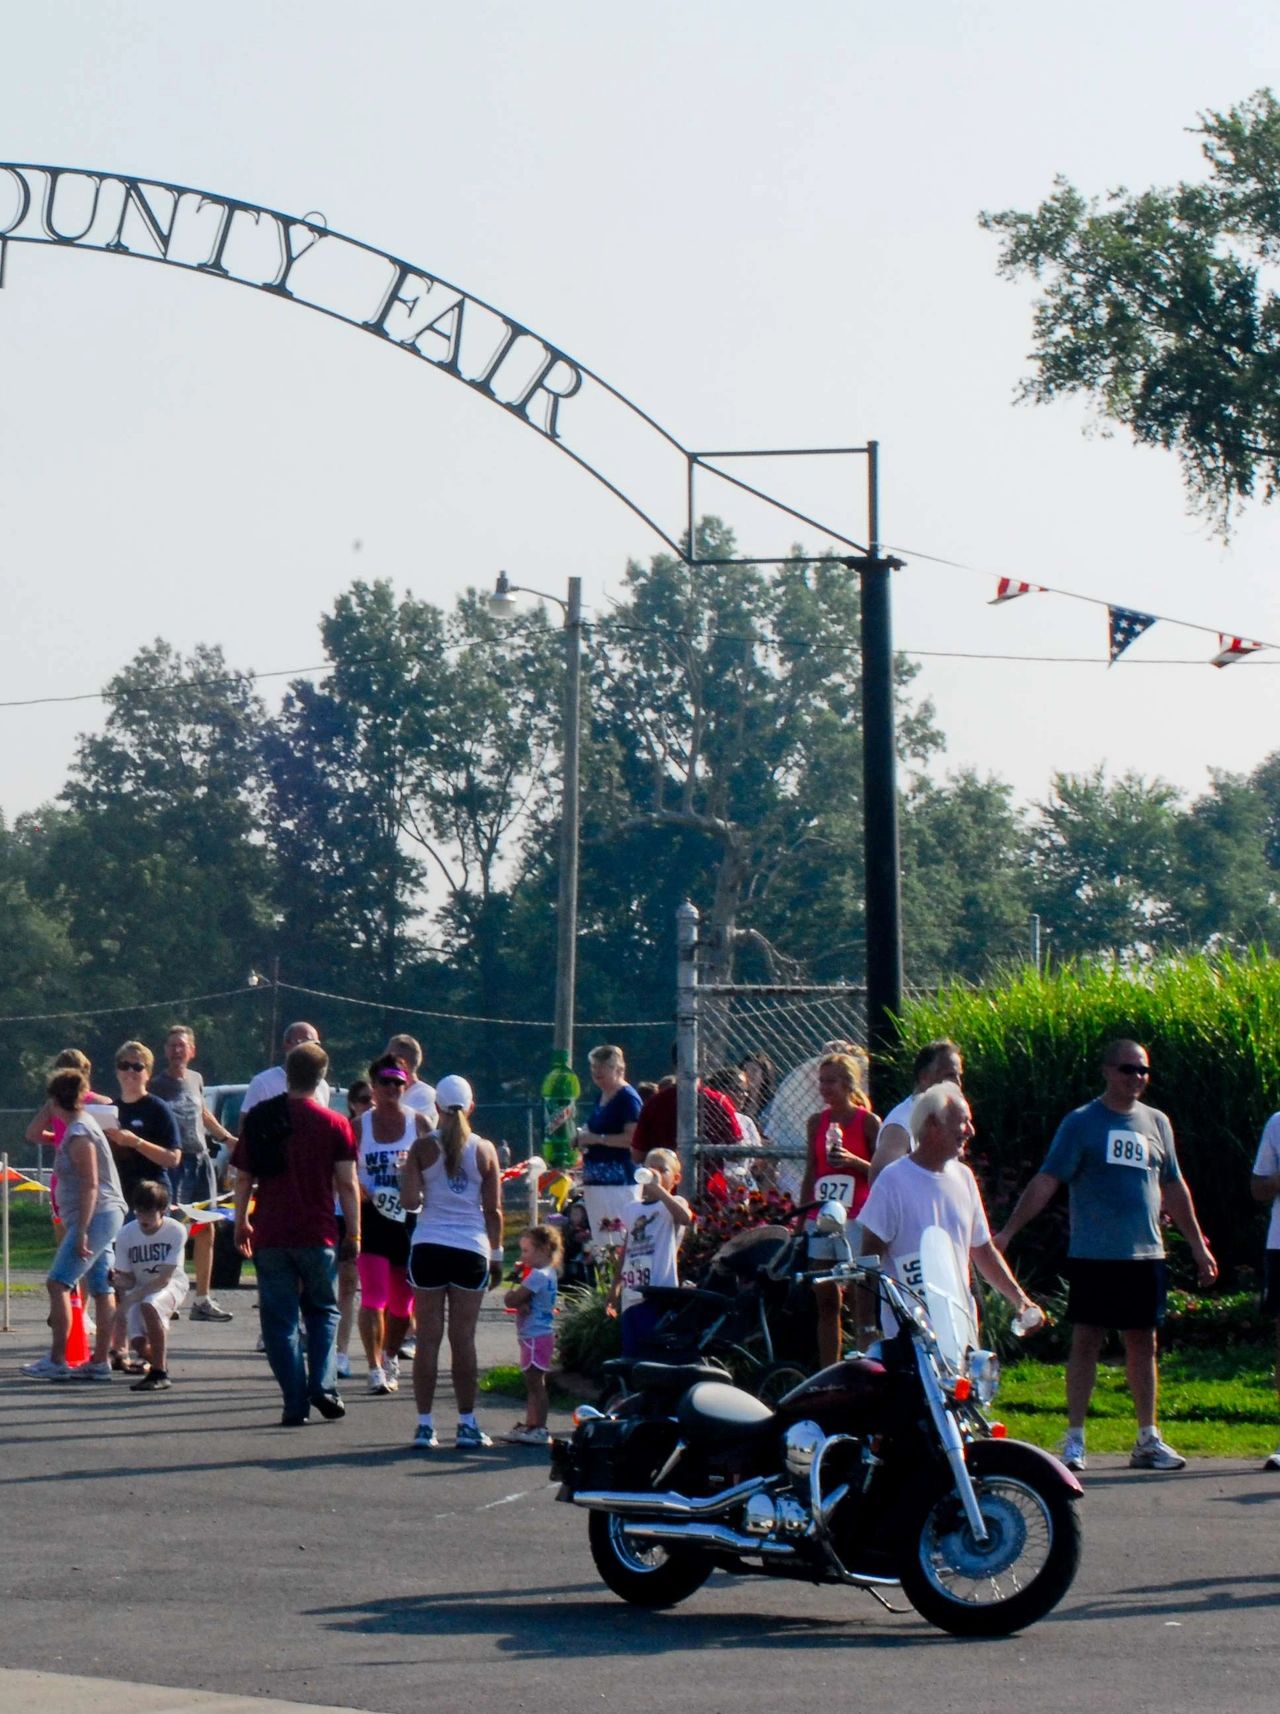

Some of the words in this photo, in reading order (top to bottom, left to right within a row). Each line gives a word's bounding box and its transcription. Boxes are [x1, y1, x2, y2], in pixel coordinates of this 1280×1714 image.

[363, 256, 584, 440] FAIR
[1113, 1139, 1143, 1161] 889
[820, 1182, 848, 1200] 927
